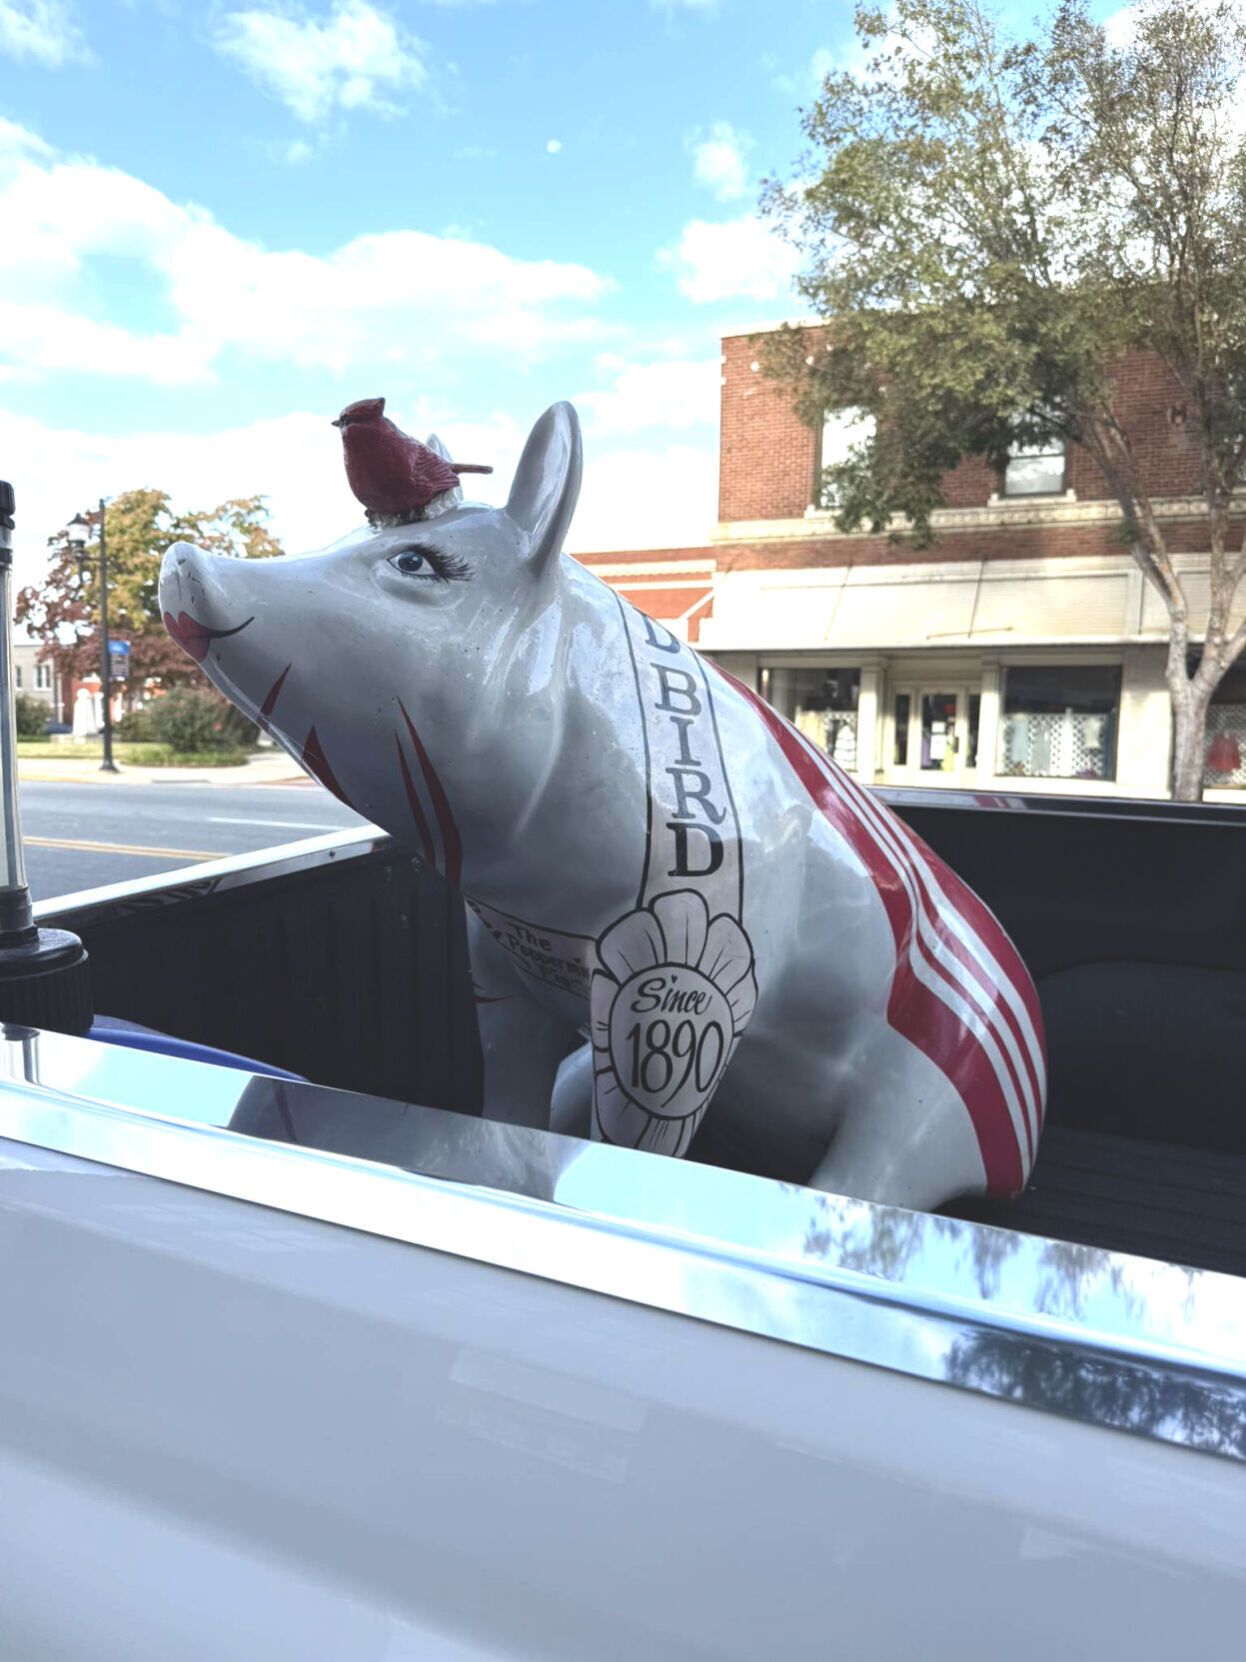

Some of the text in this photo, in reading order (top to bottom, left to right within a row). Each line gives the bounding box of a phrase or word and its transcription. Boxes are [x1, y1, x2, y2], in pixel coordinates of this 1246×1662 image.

[507, 921, 552, 952] The
[630, 975, 712, 1015] Since
[626, 1019, 724, 1107] 1890
